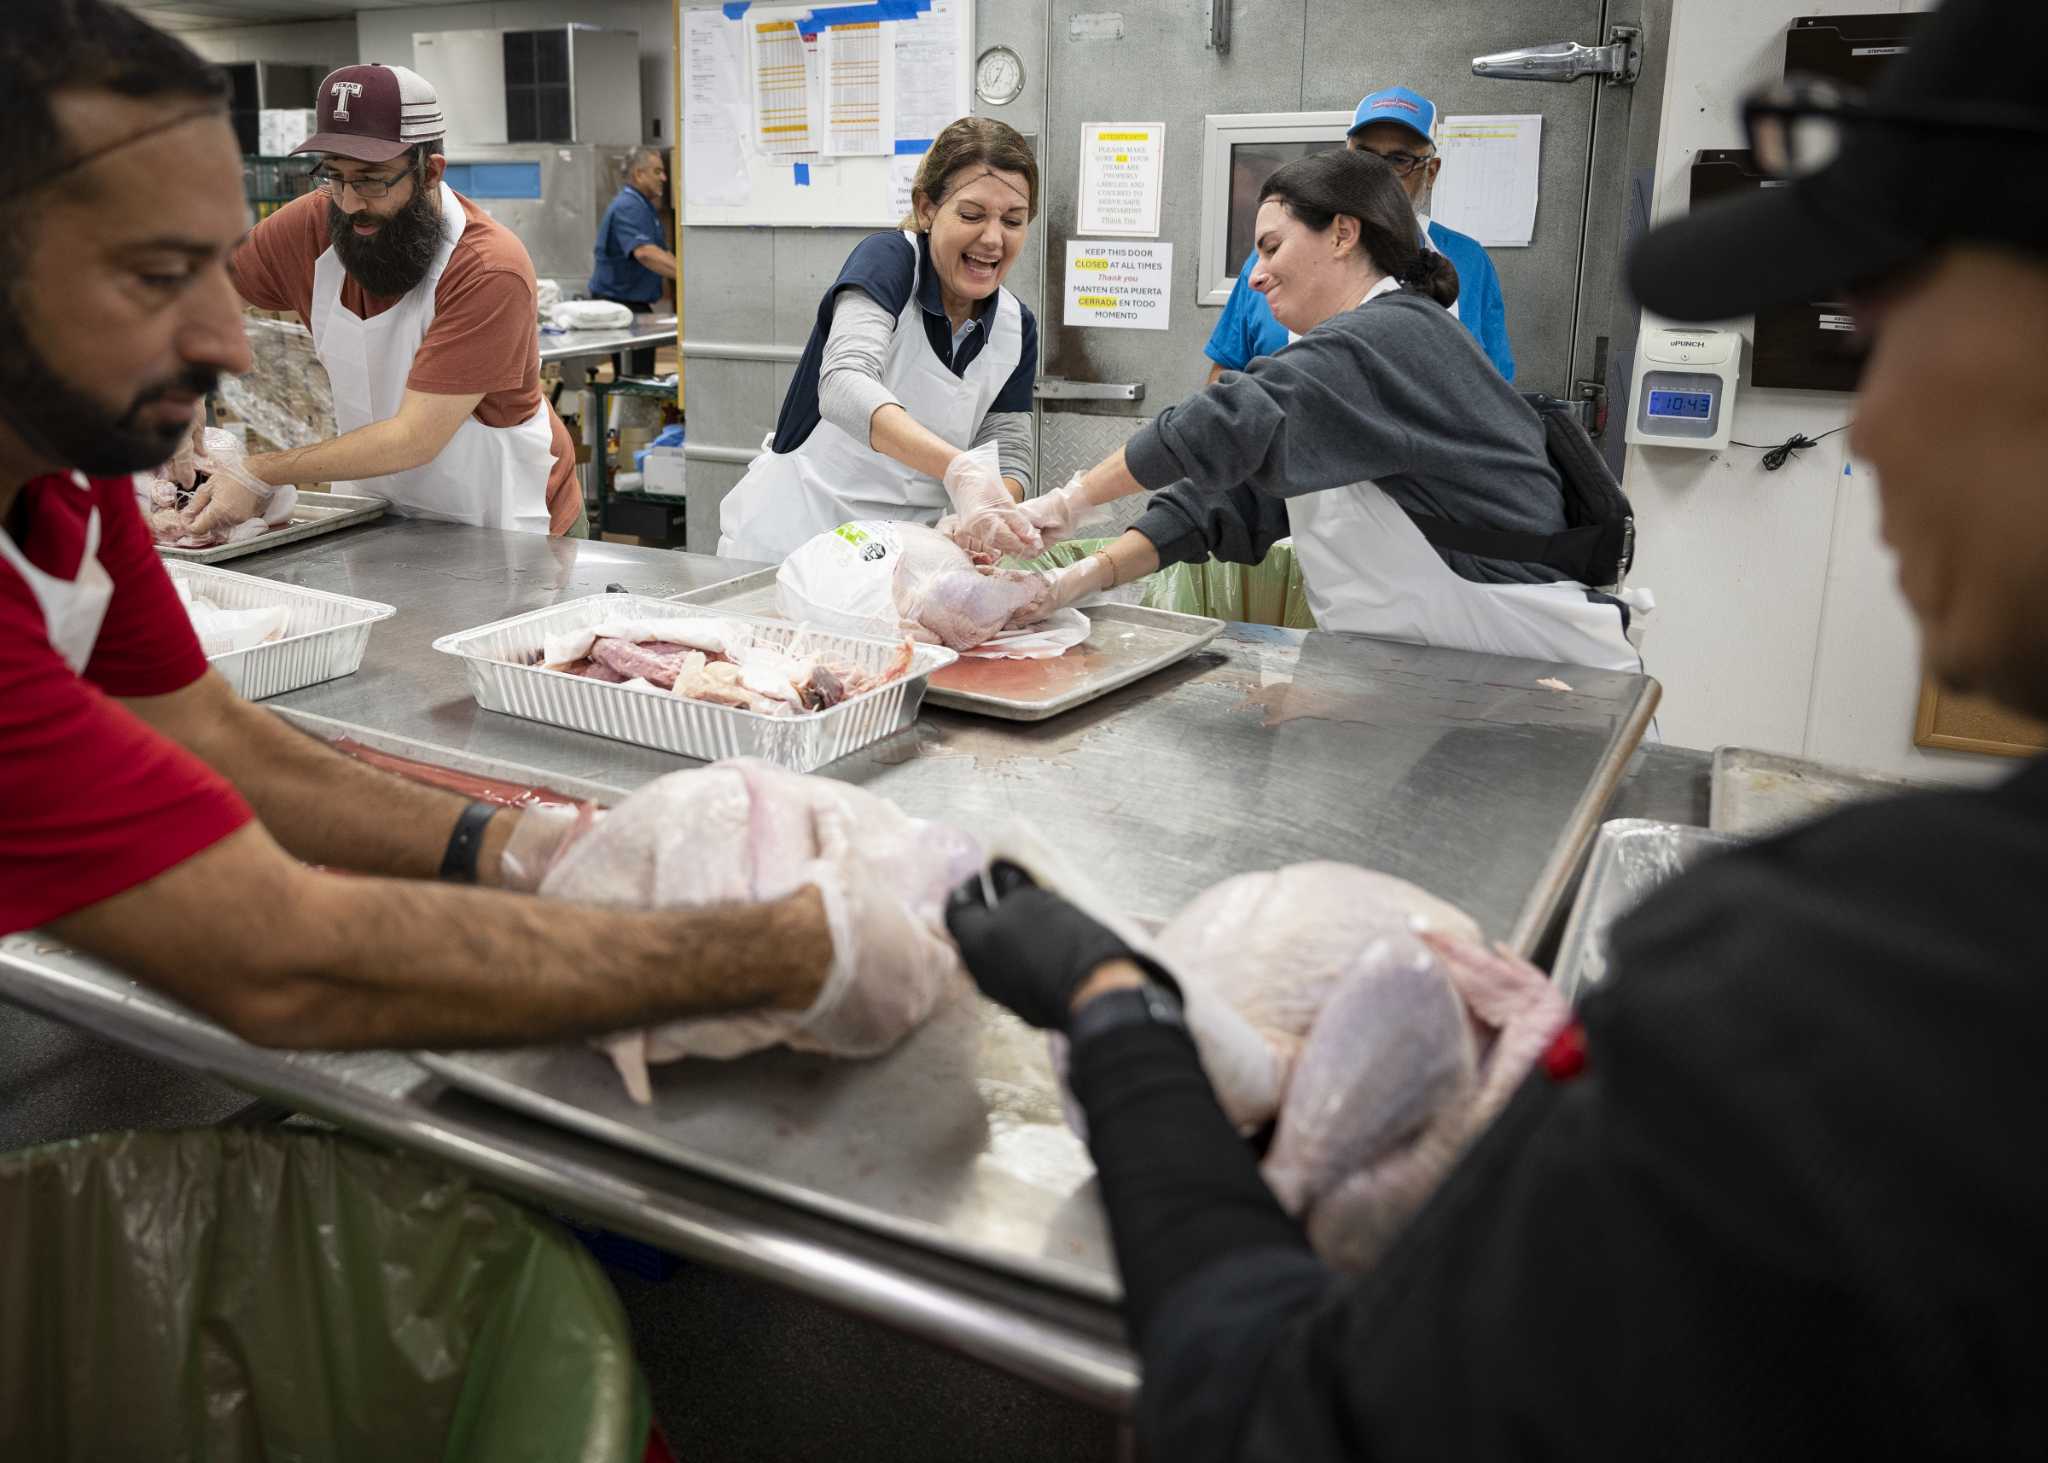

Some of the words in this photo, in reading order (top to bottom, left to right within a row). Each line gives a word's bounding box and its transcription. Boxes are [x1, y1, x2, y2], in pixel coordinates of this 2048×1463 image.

[1085, 248, 1106, 257] KEEP
[1107, 249, 1127, 257] THIS
[1128, 249, 1153, 257] DOOR
[1075, 260, 1108, 269] CLOSED
[1110, 261, 1120, 269] AT
[1121, 262, 1136, 270] ALL
[1137, 262, 1163, 271] TIMES
[1098, 274, 1122, 282] Thank
[1073, 285, 1108, 294] MANTEN
[1109, 286, 1129, 295] ESTA
[1130, 287, 1162, 296] PUERTA
[1078, 297, 1117, 307] CERRADA
[1119, 299, 1130, 307] EN
[1132, 299, 1156, 308] TODO
[1095, 311, 1138, 320] MOMENTO
[1666, 397, 1709, 412] 10:43
